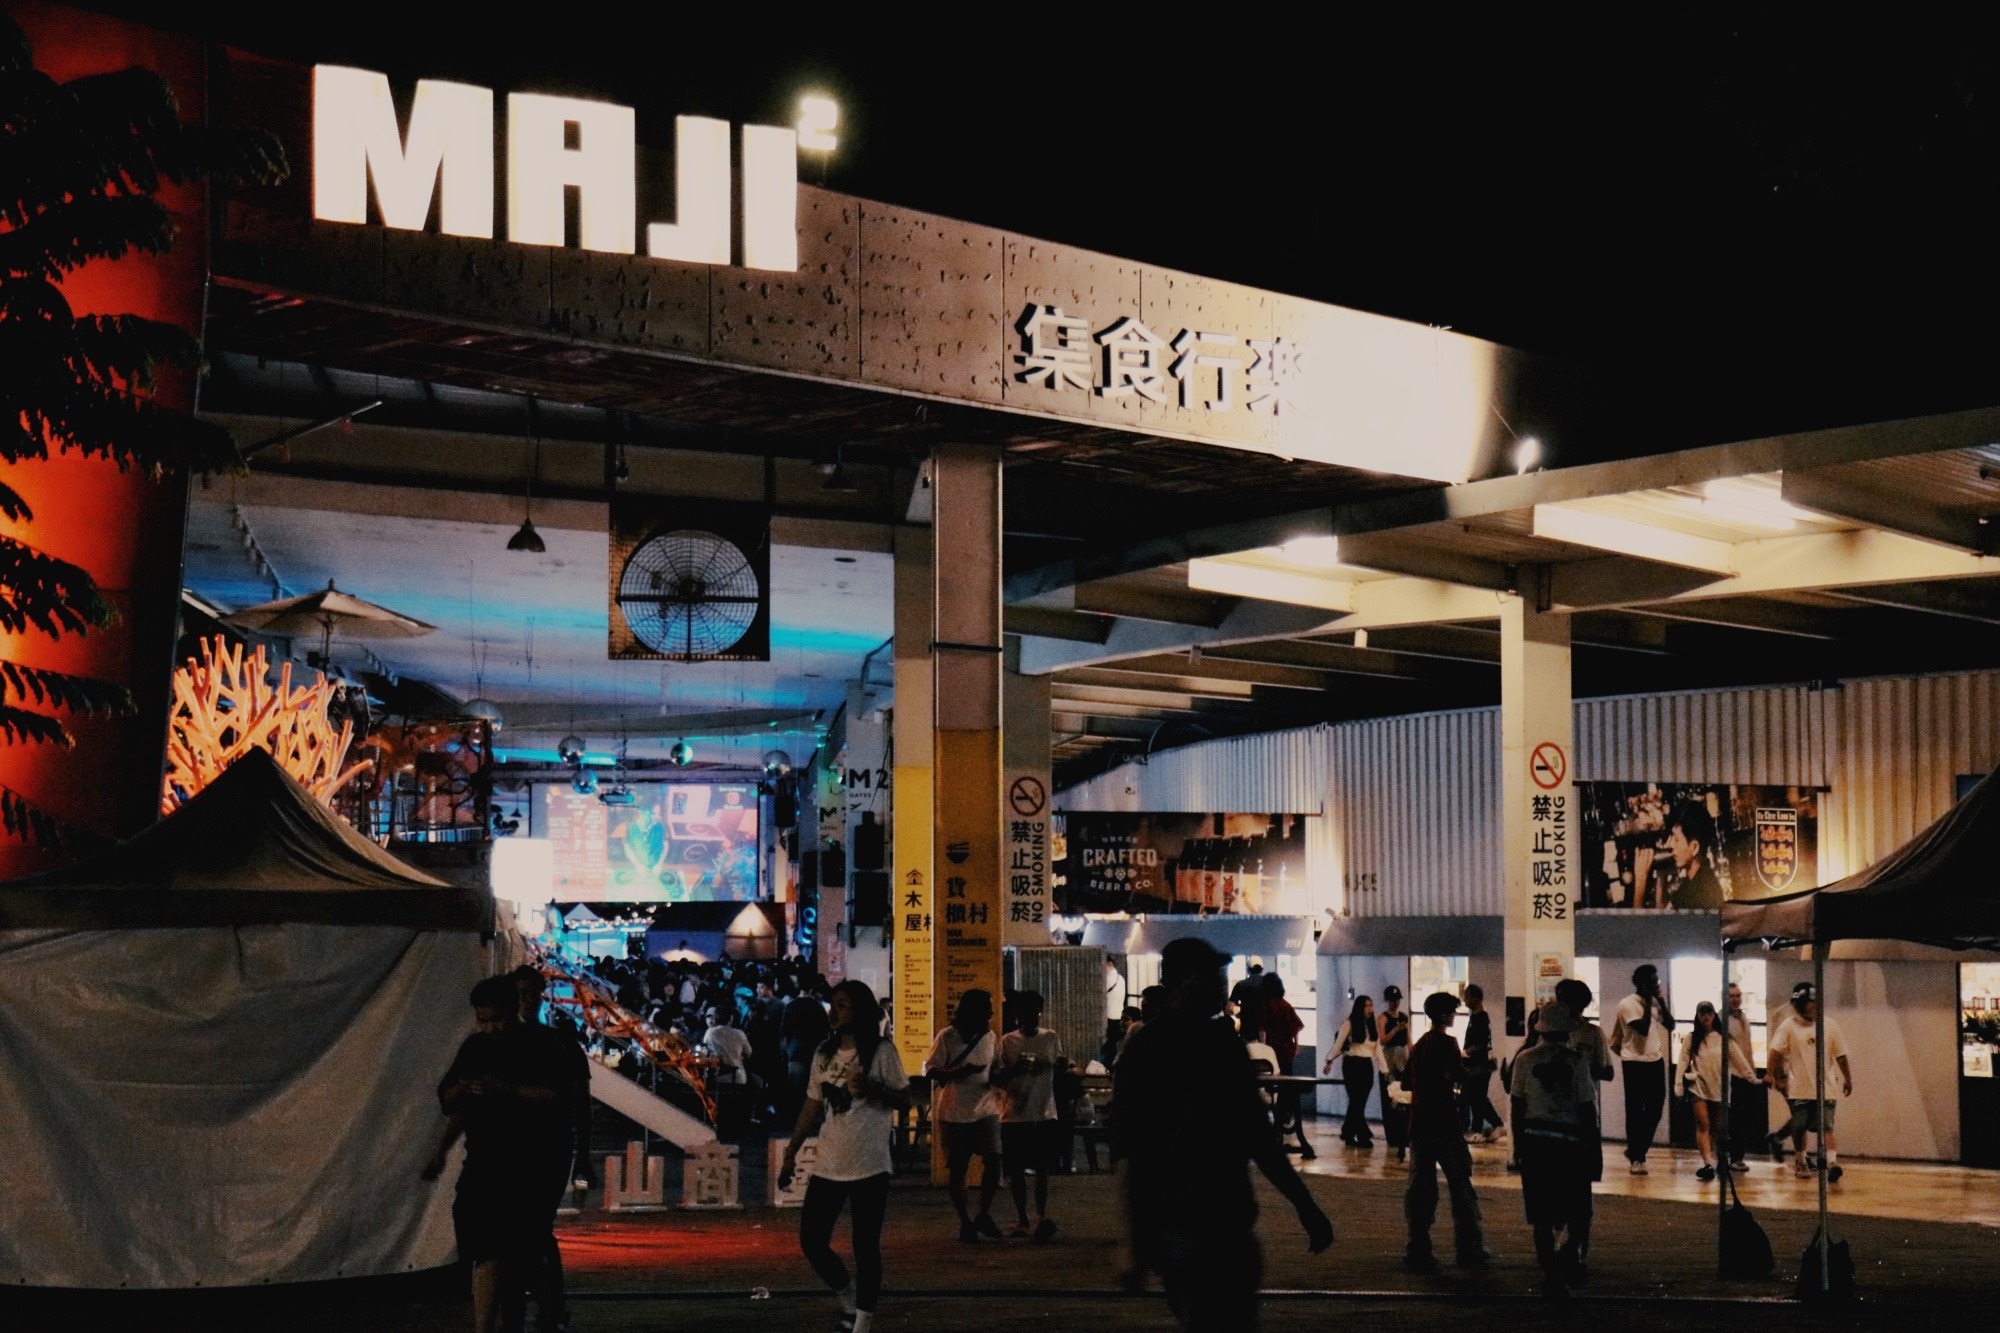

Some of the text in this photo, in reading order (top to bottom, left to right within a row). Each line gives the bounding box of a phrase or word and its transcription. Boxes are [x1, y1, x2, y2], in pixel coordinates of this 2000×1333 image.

[1011, 821, 1032, 923] 禁止吸菸
[1031, 822, 1044, 923] NO SMOKING
[1083, 848, 1157, 867] CRAFTED
[1090, 879, 1121, 891] BEER
[1532, 794, 1553, 920] 禁止吸菸
[1554, 796, 1567, 920] NO SMOKING
